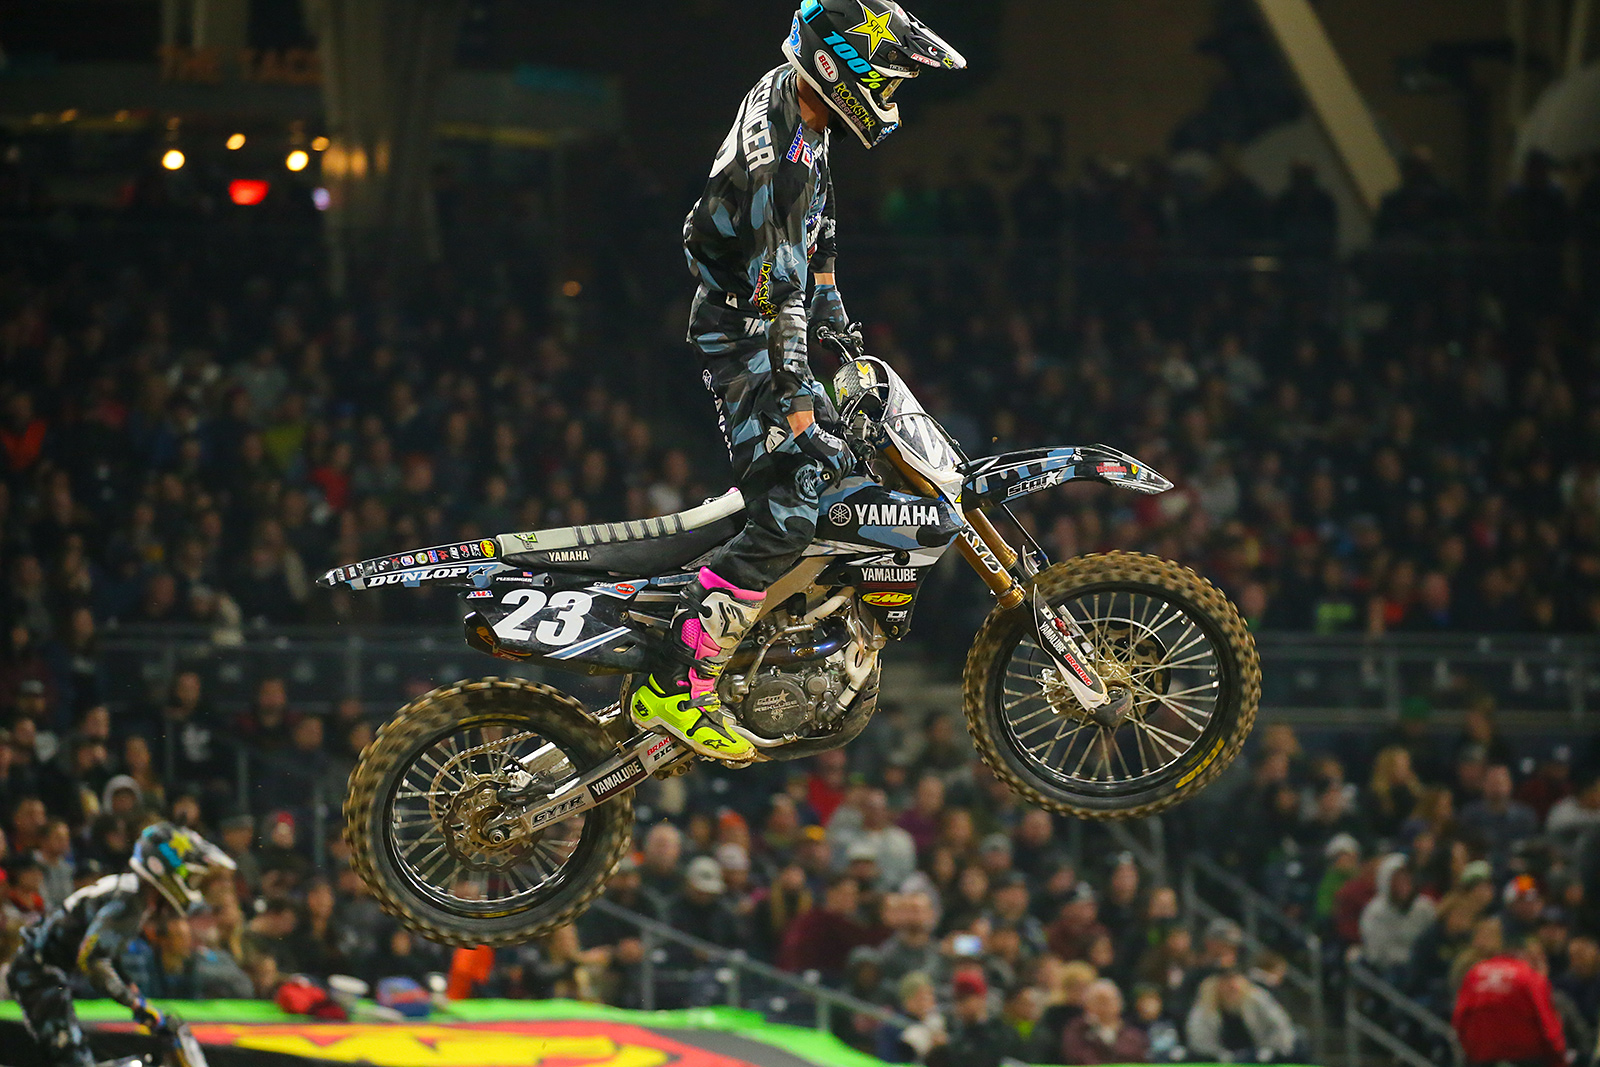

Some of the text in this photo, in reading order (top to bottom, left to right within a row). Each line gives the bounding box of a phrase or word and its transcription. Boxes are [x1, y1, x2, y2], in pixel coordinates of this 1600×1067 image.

[818, 54, 834, 78] BELL
[823, 31, 887, 89] 100%
[855, 504, 940, 526] YAMAHA
[548, 550, 589, 562] YAMAHA
[367, 567, 468, 588] DUNLOP
[861, 568, 917, 582] YAMALUBE
[862, 593, 913, 605] FMF
[493, 588, 593, 646] 23
[1039, 621, 1067, 655] YAMALUBE
[1064, 653, 1093, 686] BRAKING
[592, 761, 642, 796] YAMALUBE
[532, 795, 584, 825] GYTR
